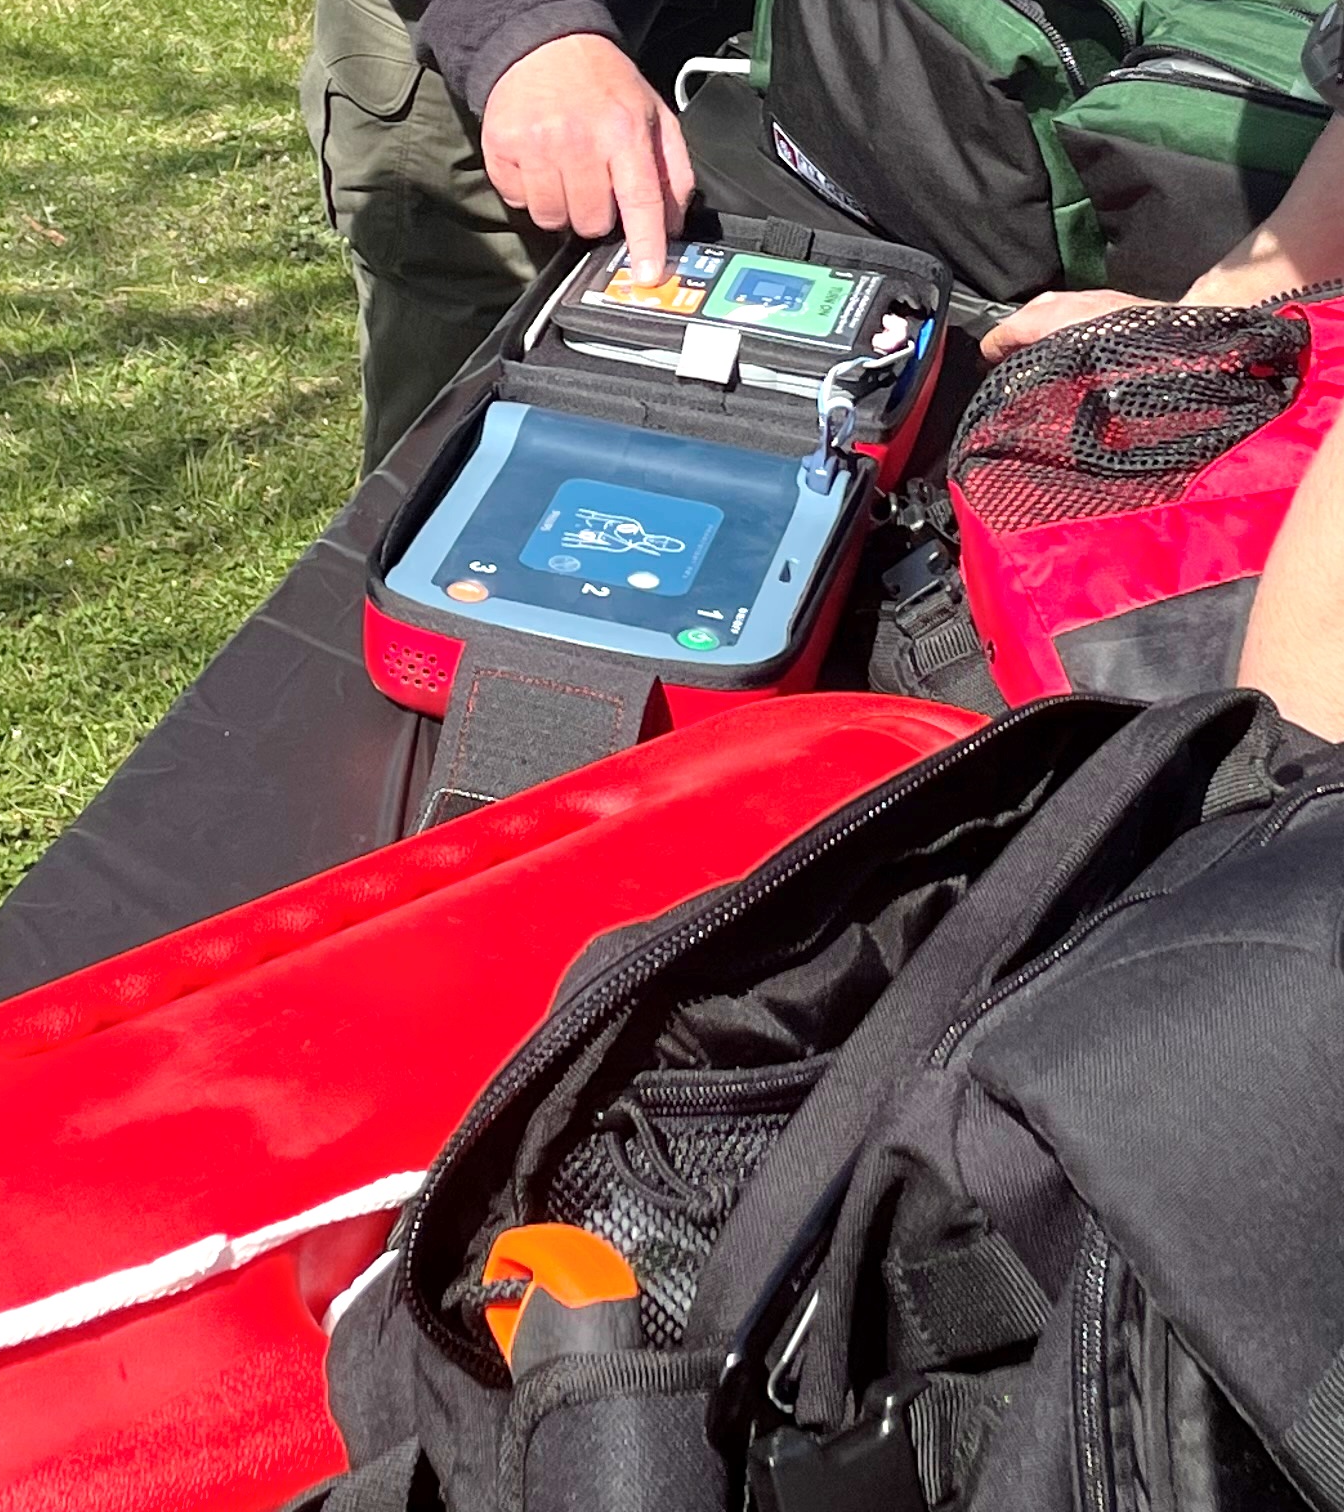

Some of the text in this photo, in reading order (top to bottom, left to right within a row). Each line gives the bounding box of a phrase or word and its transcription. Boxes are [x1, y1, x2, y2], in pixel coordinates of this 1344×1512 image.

[469, 560, 498, 576] 3
[581, 582, 612, 598] 2
[696, 608, 724, 622] 1
